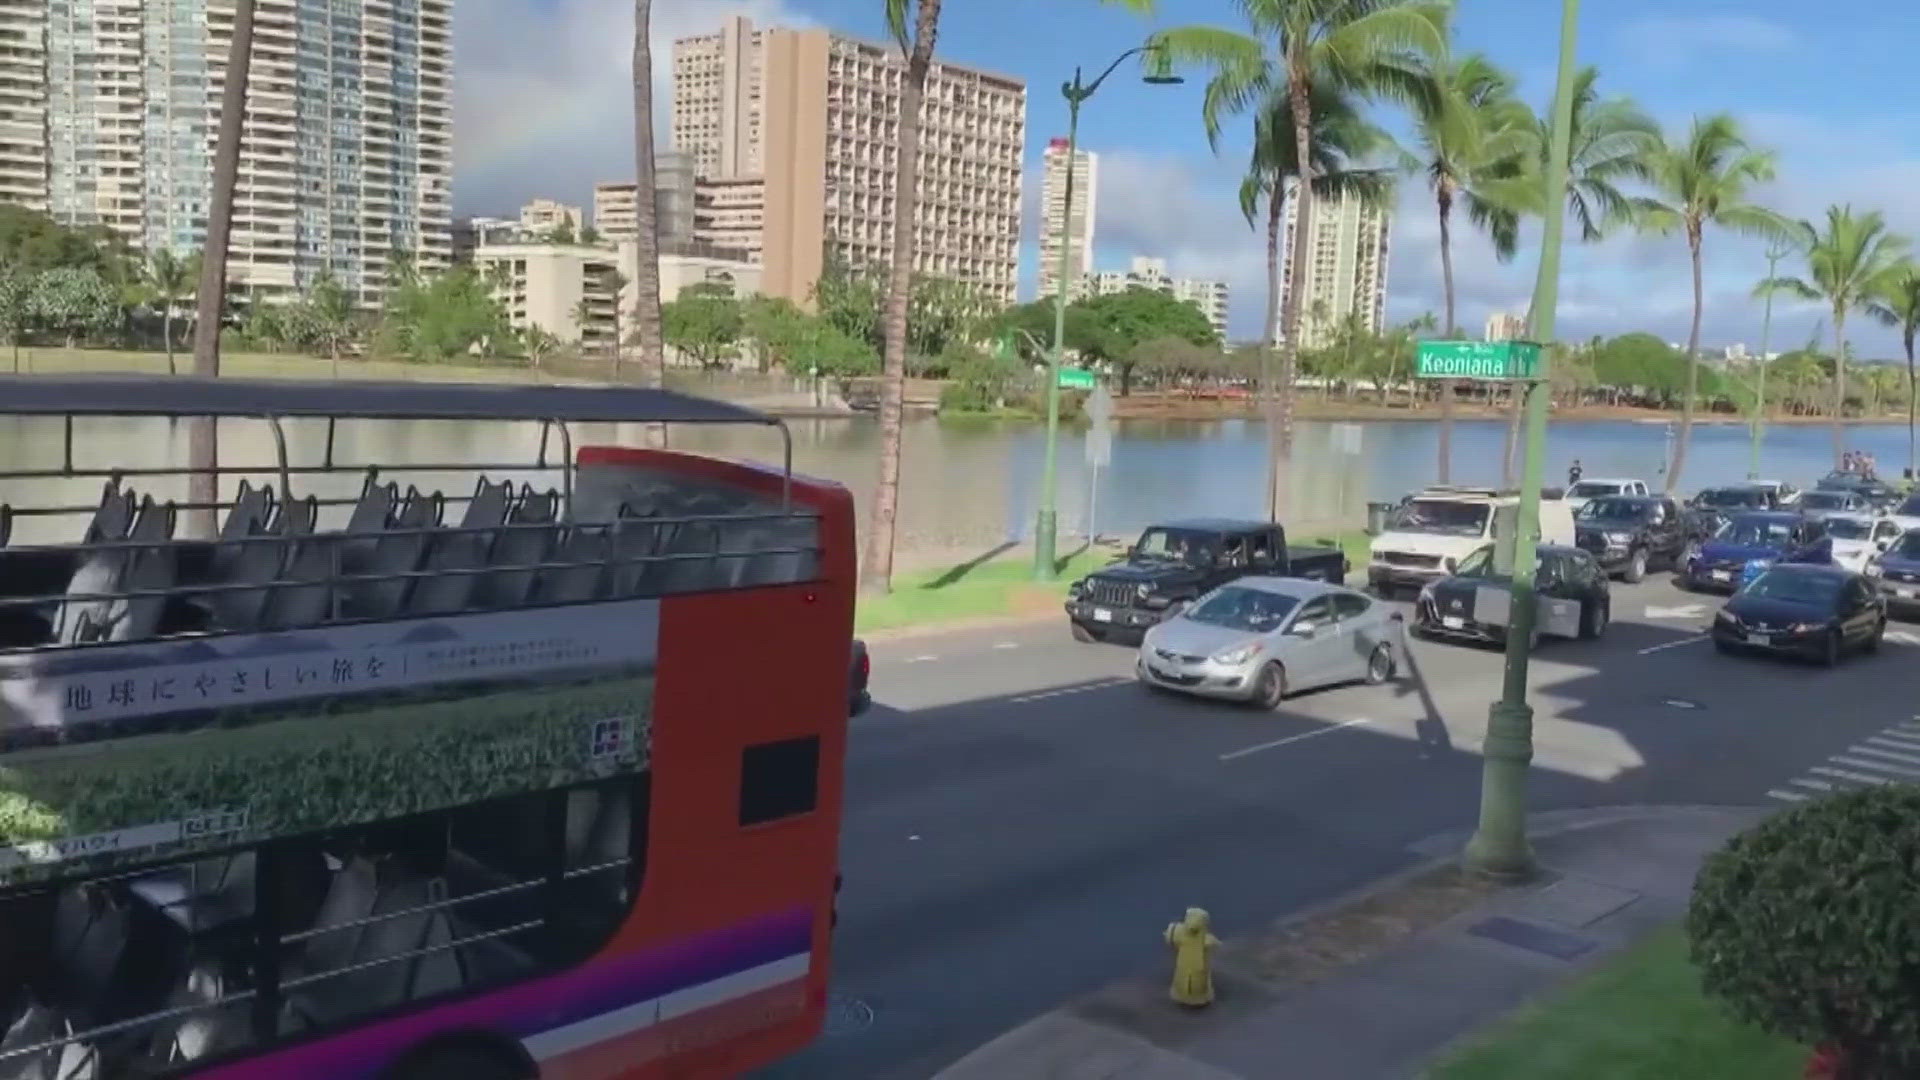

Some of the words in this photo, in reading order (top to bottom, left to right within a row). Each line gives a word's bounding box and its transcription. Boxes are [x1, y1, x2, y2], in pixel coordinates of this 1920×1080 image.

[1422, 352, 1503, 376] Keoniana
[65, 655, 386, 710] 地球にやさしい旅を
